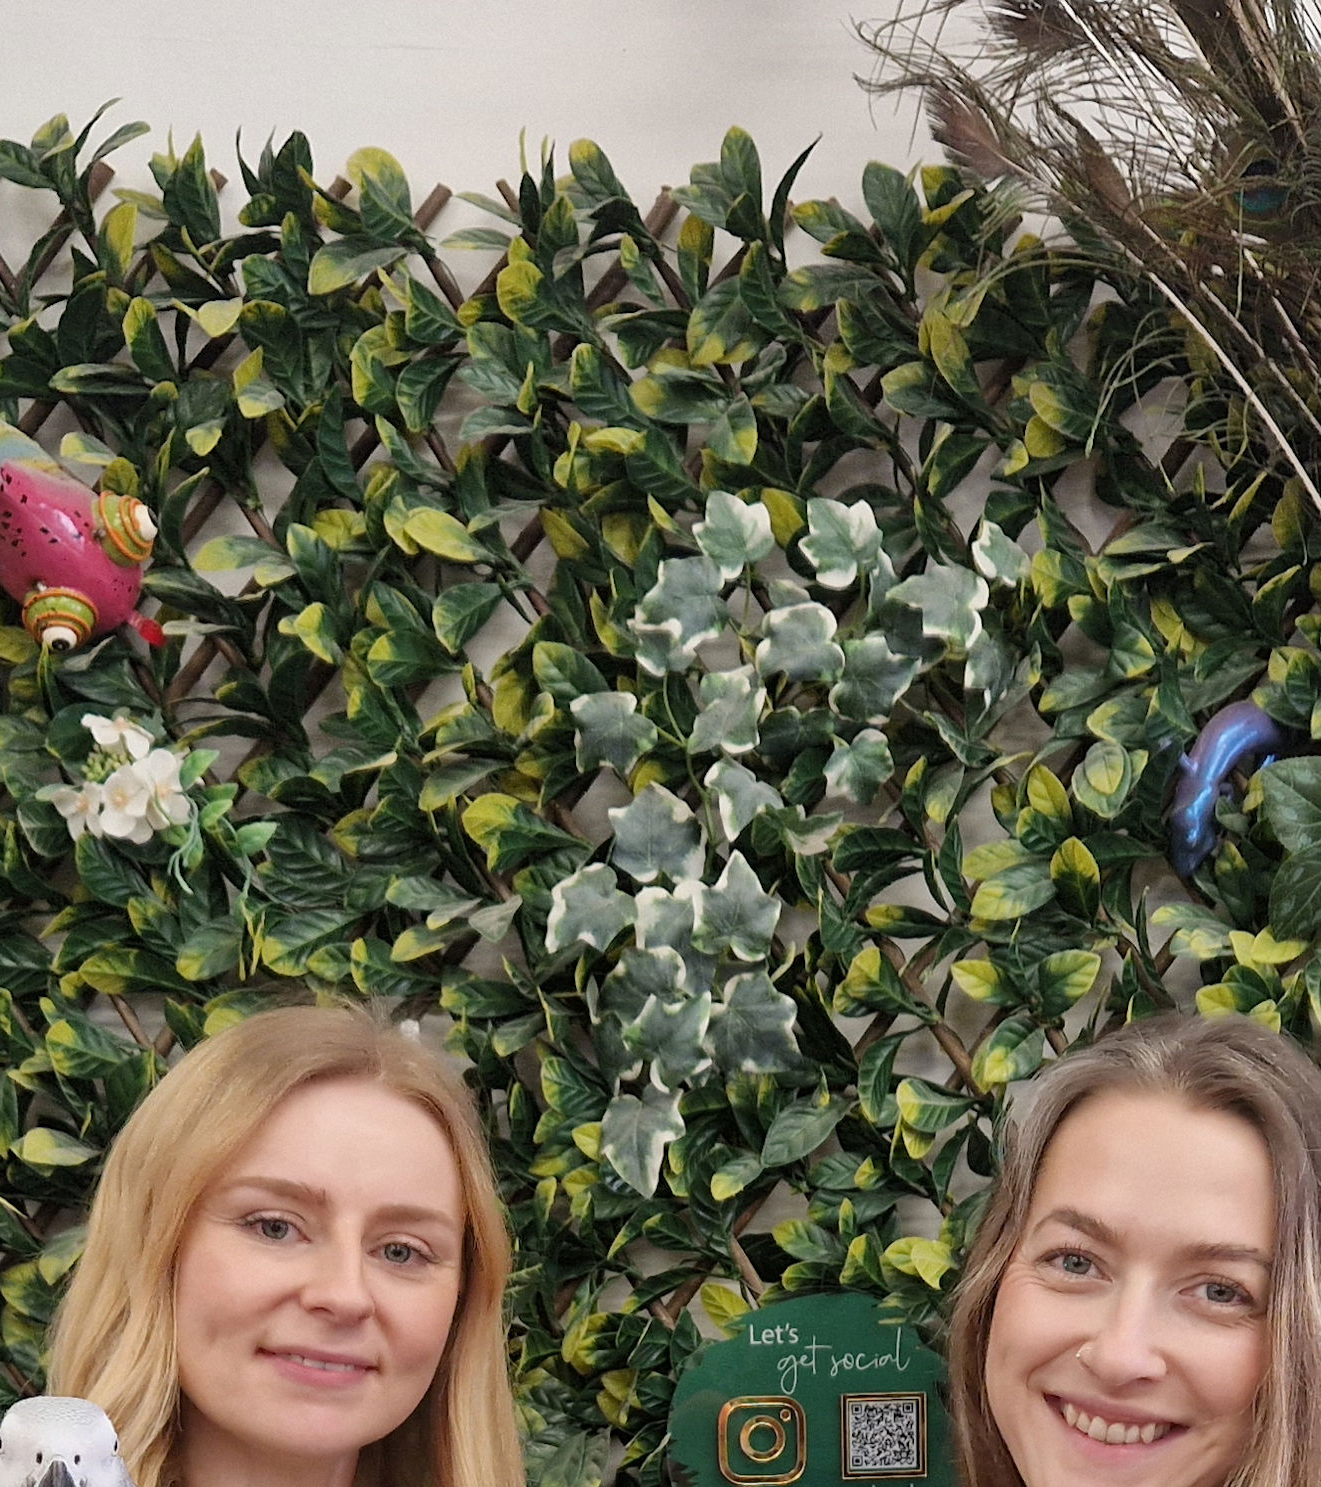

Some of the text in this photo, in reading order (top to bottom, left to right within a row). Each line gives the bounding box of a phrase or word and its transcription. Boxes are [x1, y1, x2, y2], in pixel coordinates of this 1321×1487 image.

[749, 1323, 799, 1345] Let's
[777, 1326, 910, 1395] get social
